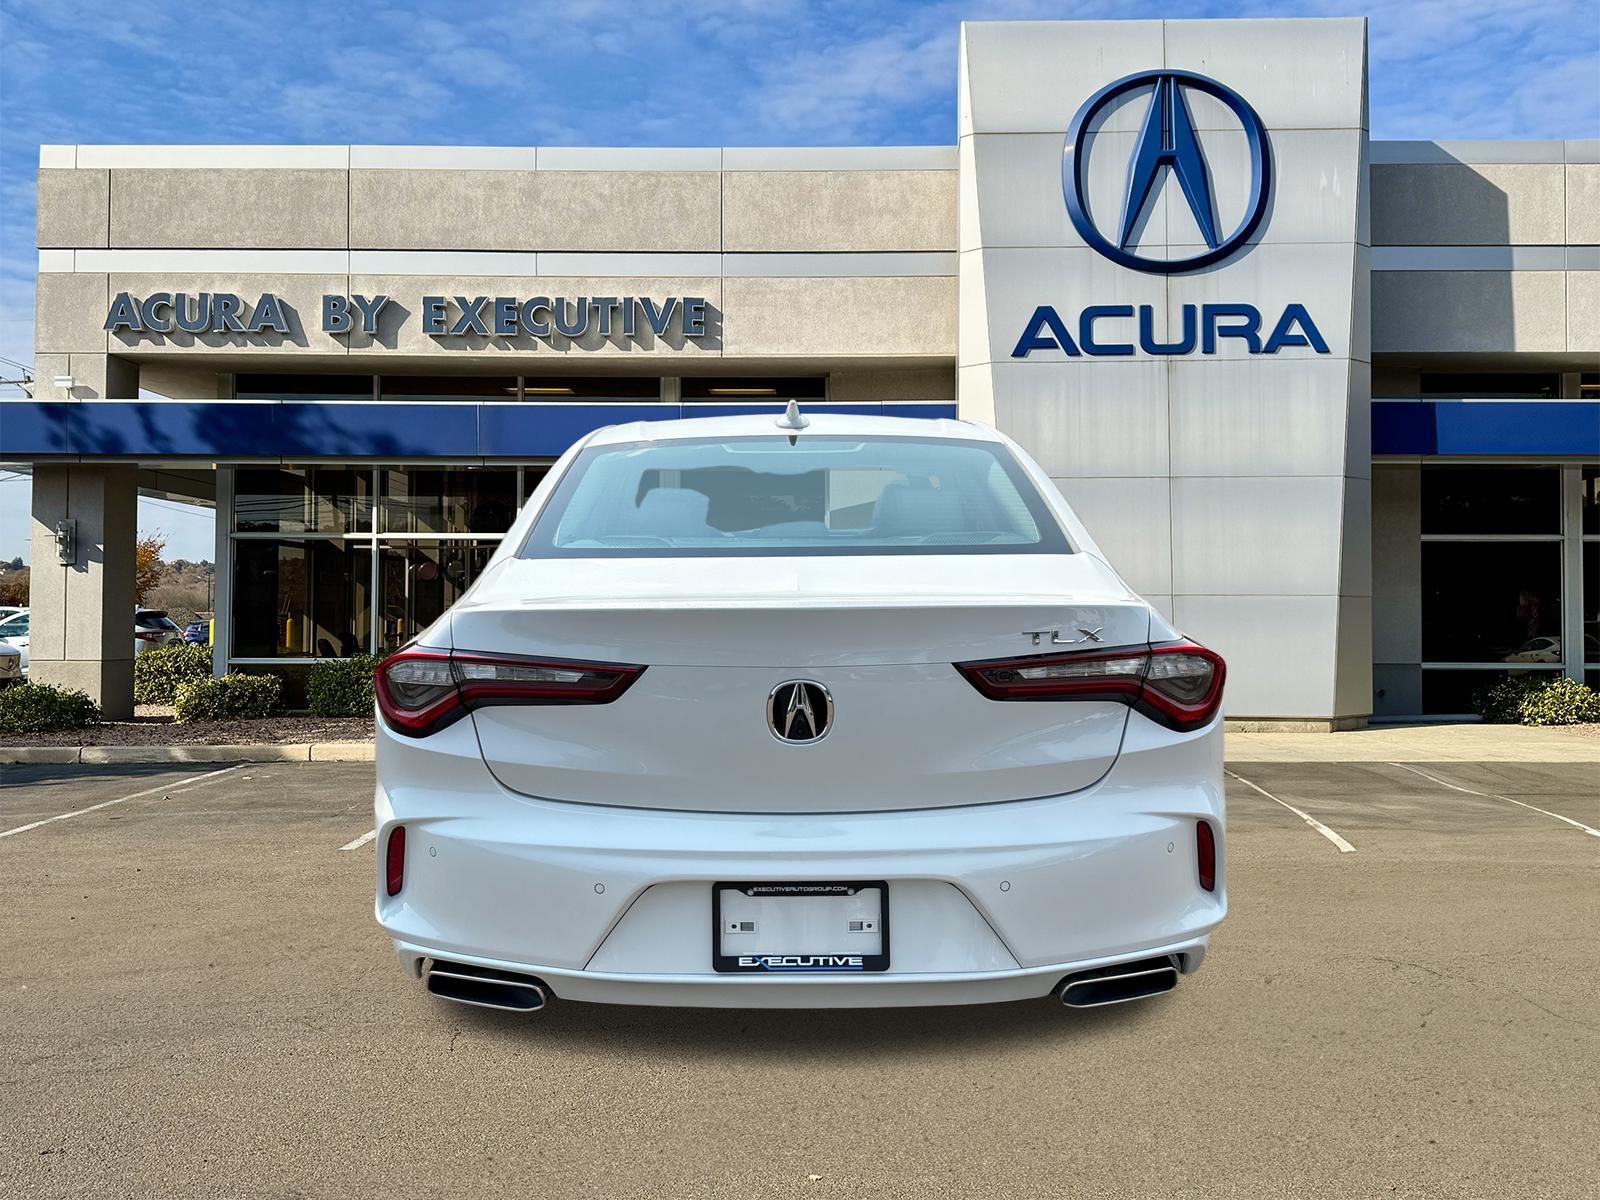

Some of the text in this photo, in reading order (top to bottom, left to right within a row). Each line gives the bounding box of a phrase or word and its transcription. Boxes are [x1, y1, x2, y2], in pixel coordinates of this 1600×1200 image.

[103, 292, 706, 336] ACURA BY EXECUTIVE
[1010, 303, 1331, 357] ACURA
[1022, 627, 1104, 646] TLX
[738, 957, 863, 967] EXECUTIVE
